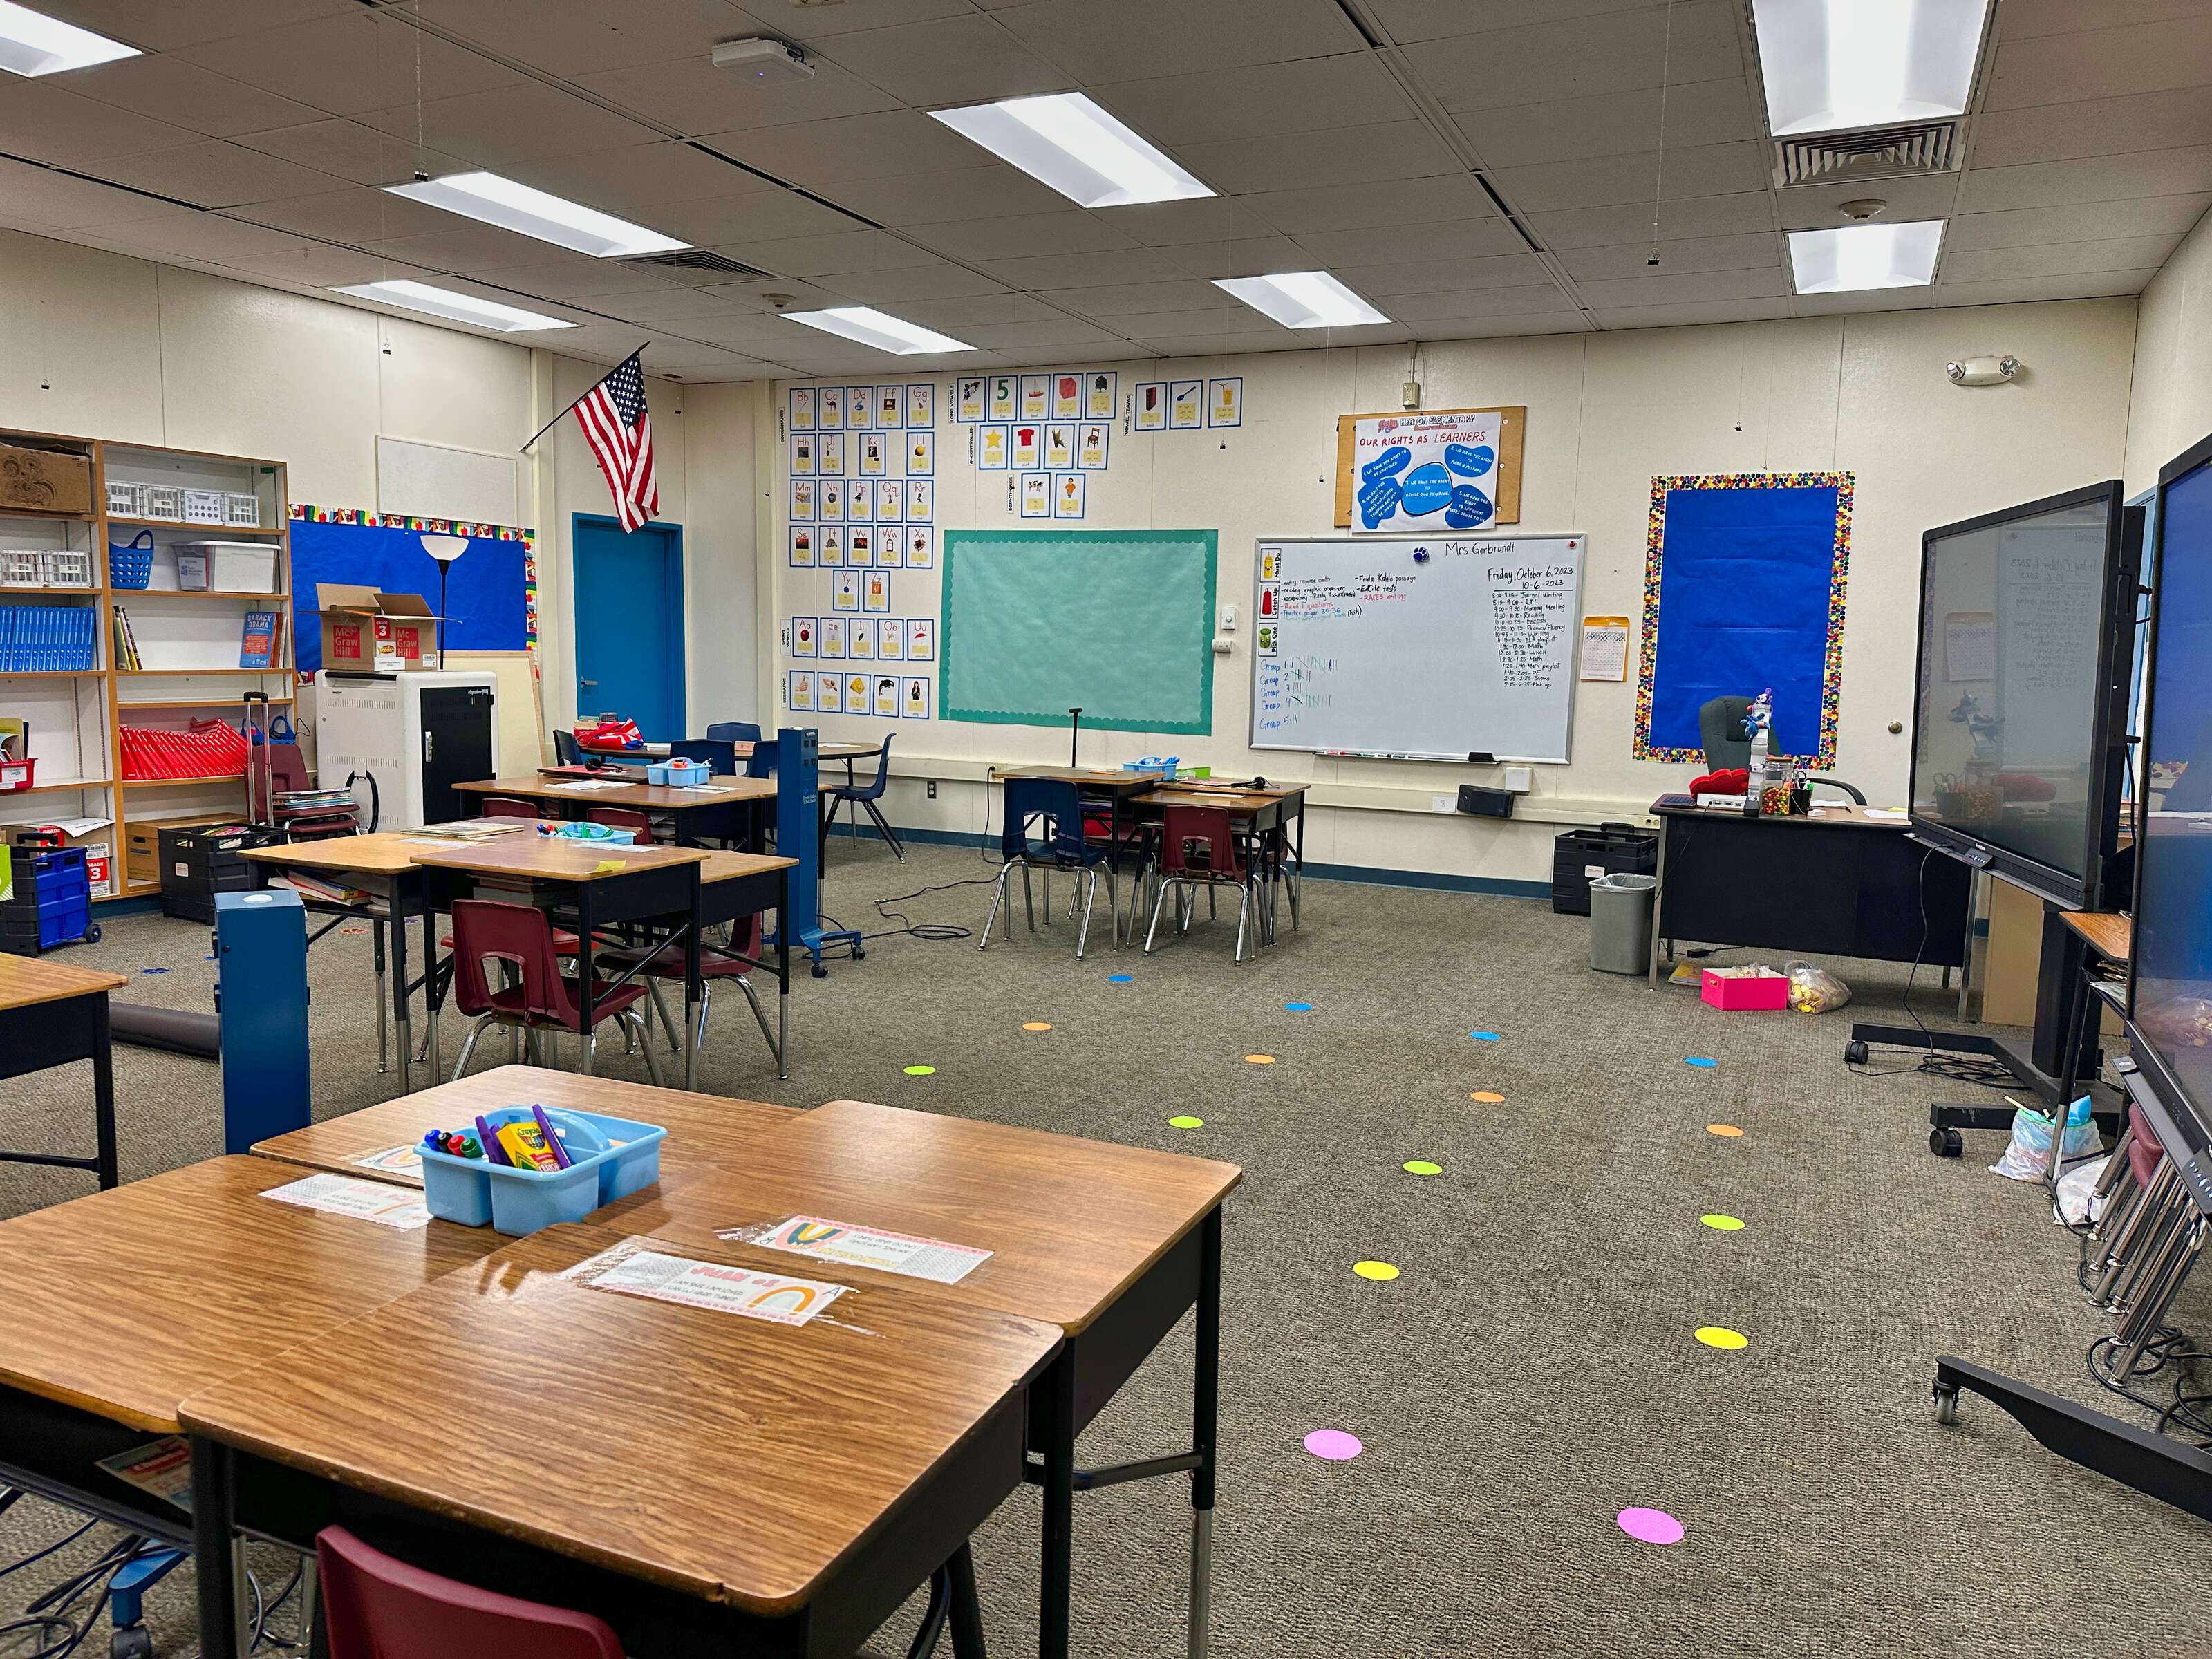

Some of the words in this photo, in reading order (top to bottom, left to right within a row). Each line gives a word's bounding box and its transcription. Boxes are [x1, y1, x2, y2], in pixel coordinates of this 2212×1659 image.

[997, 379, 1009, 400] 5
[1400, 417, 1427, 426] HEATON
[1428, 415, 1475, 424] ELEMENTARY
[1360, 438, 1378, 447] OUR
[1382, 435, 1414, 447] RIGHTS
[1416, 435, 1428, 444] AS
[1434, 431, 1486, 443] LEARNERS
[1445, 541, 1468, 556] Mrs
[1472, 542, 1515, 554] Gerbrandt
[1275, 553, 1280, 561] Do
[1554, 567, 1573, 575] 2023
[1378, 572, 1393, 582] Kahlo
[1275, 588, 1279, 597] Up
[379, 625, 387, 637] 3
[397, 630, 409, 638] Mc
[335, 637, 358, 646] Graw
[397, 639, 417, 648] Graw
[336, 646, 350, 655] Hill
[397, 648, 411, 657] Hill
[1260, 659, 1280, 674] Group
[1260, 675, 1279, 686] Group
[1261, 687, 1280, 698] Group
[1262, 700, 1280, 712] Group
[1259, 718, 1280, 730] Group
[90, 868, 101, 880] 3
[517, 1127, 542, 1136] Crayola
[691, 1266, 751, 1282] JUAN
